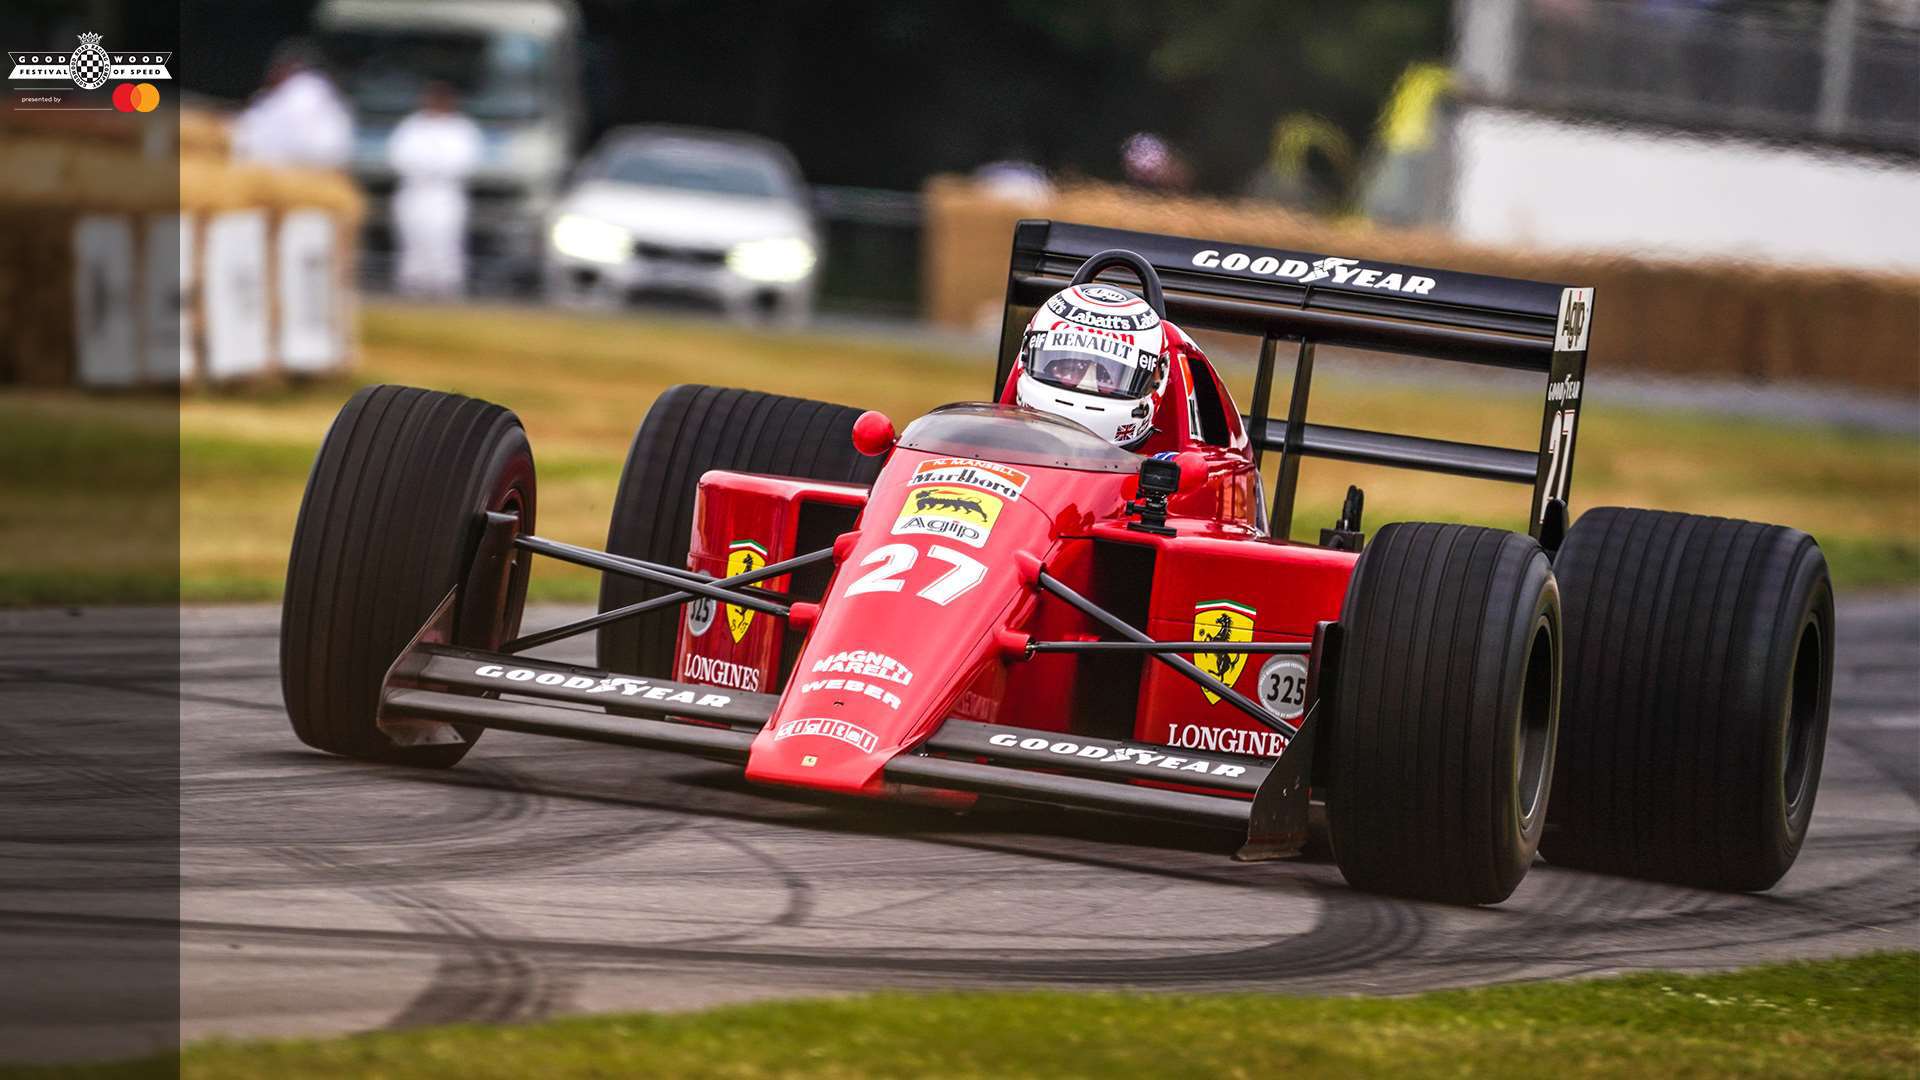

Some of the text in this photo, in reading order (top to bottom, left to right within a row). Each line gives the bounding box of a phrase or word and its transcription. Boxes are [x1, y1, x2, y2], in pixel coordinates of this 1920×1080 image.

[1561, 290, 1585, 350] Agip
[1052, 333, 1132, 360] RENAULT
[1139, 353, 1158, 373] elf
[913, 468, 1017, 498] Marlboro
[1539, 410, 1575, 524] 27
[901, 516, 980, 541] Agip
[843, 543, 989, 606] 27
[684, 653, 760, 692] LONGINES
[812, 650, 913, 681] MAGNETI
[801, 679, 902, 710] WEBER
[1267, 673, 1306, 706] 325
[1167, 723, 1291, 757] LONGINE
